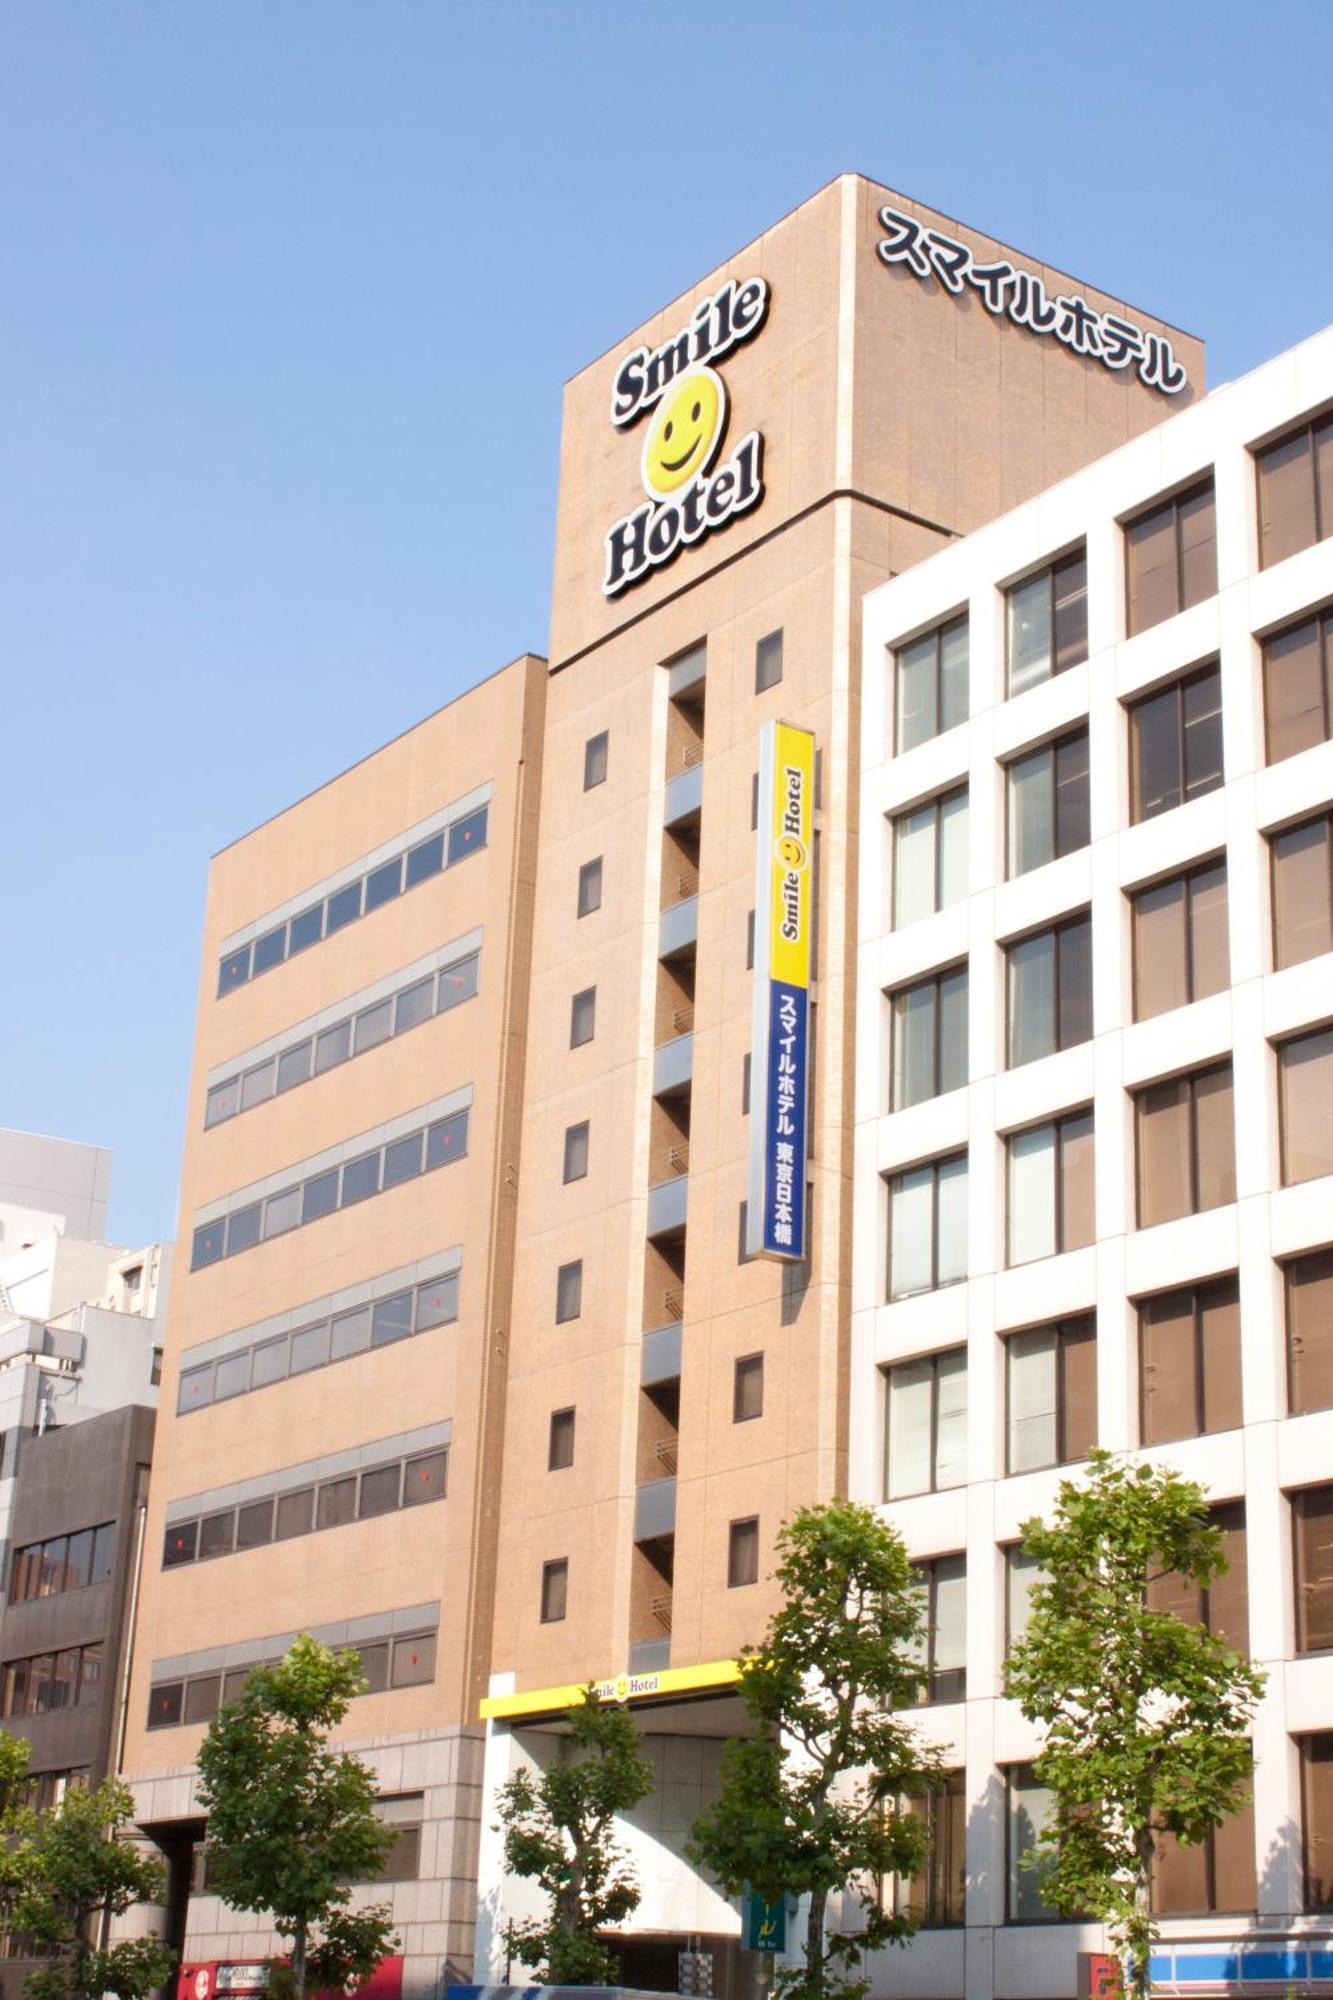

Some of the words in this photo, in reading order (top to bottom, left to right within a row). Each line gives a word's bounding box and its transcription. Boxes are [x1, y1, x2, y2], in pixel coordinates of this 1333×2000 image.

[613, 279, 767, 425] Smile
[879, 207, 1186, 392] スマイルホテル
[605, 435, 760, 593] Hotel
[785, 768, 802, 835] Hotel
[782, 872, 799, 940] Smile
[776, 994, 797, 1136] スマイルホテル
[774, 1142, 795, 1246] 東京日本橋
[630, 1677, 658, 1692] Hotel
